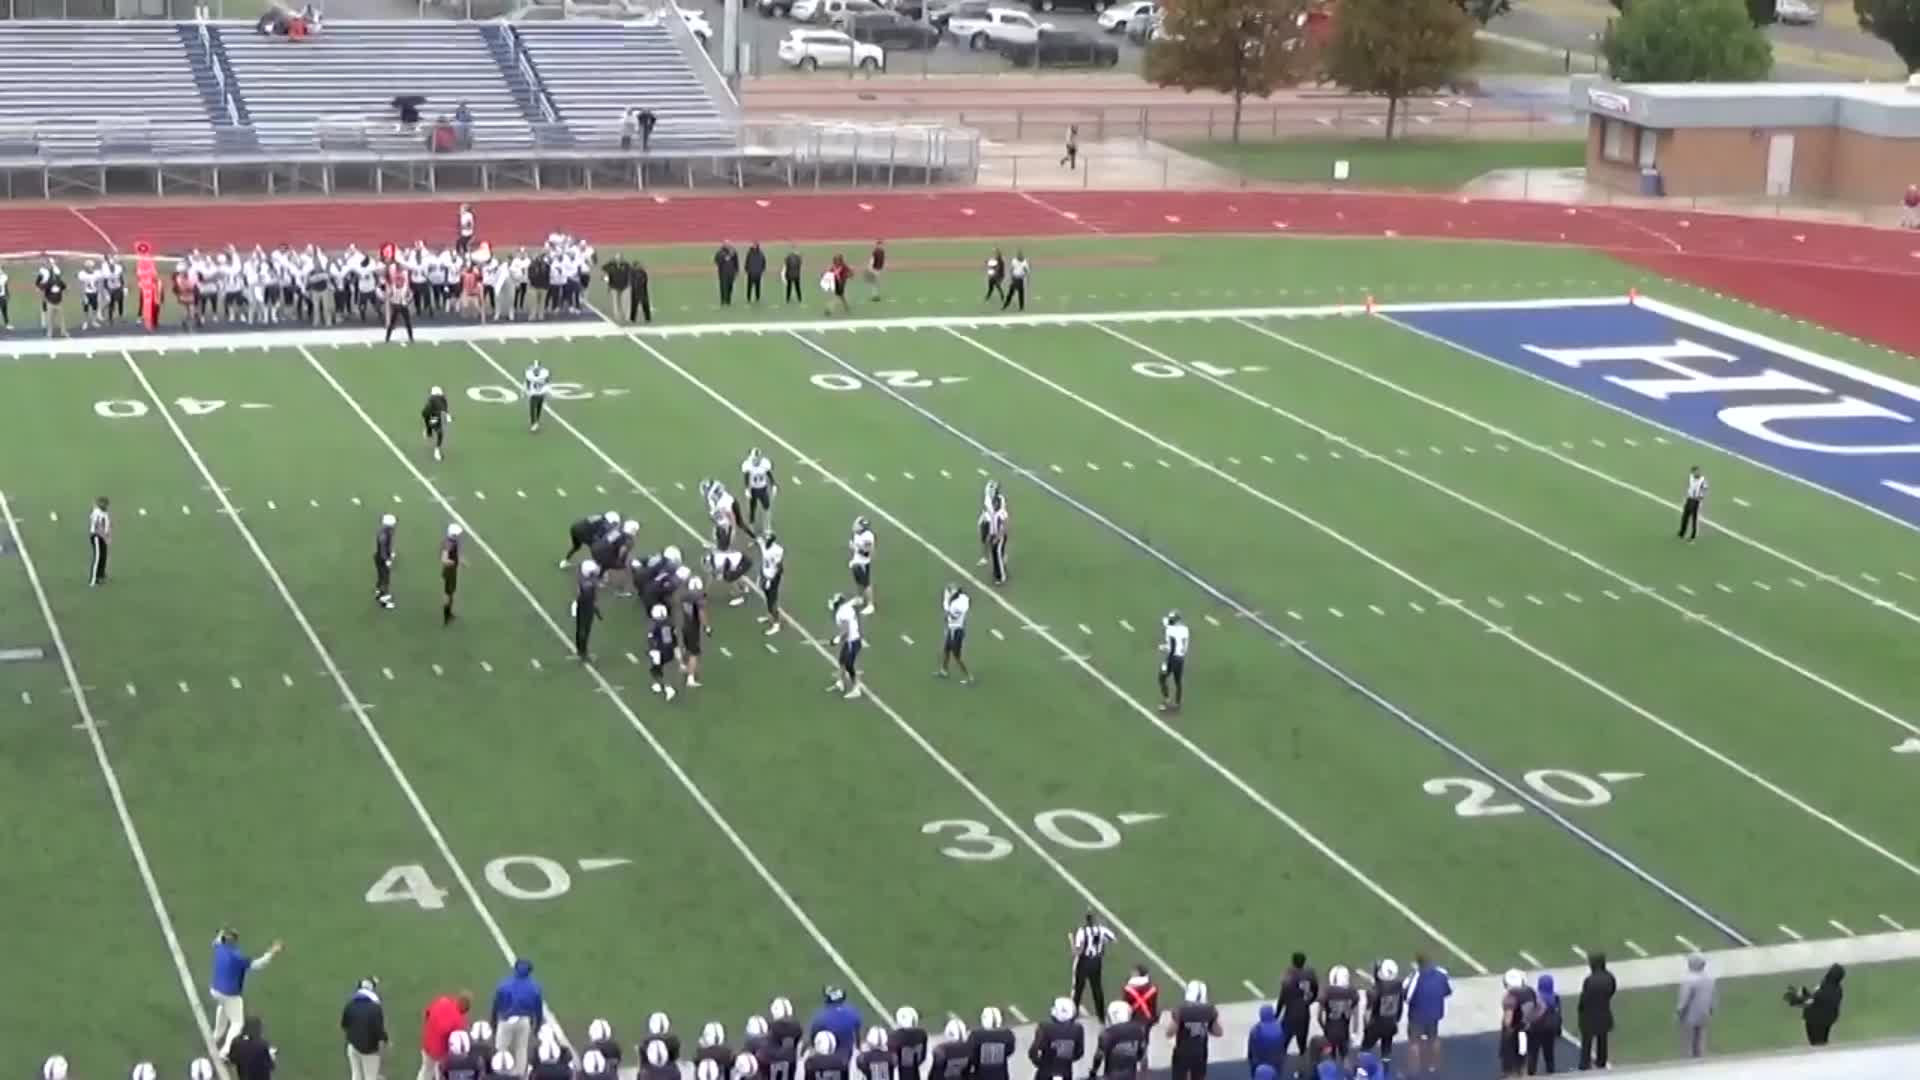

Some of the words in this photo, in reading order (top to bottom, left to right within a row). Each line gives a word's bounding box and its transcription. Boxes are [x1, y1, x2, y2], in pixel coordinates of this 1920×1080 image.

[1521, 338, 1920, 498] HU
[1423, 769, 1611, 816] 20
[921, 808, 1121, 860] 30
[365, 855, 571, 909] 40
